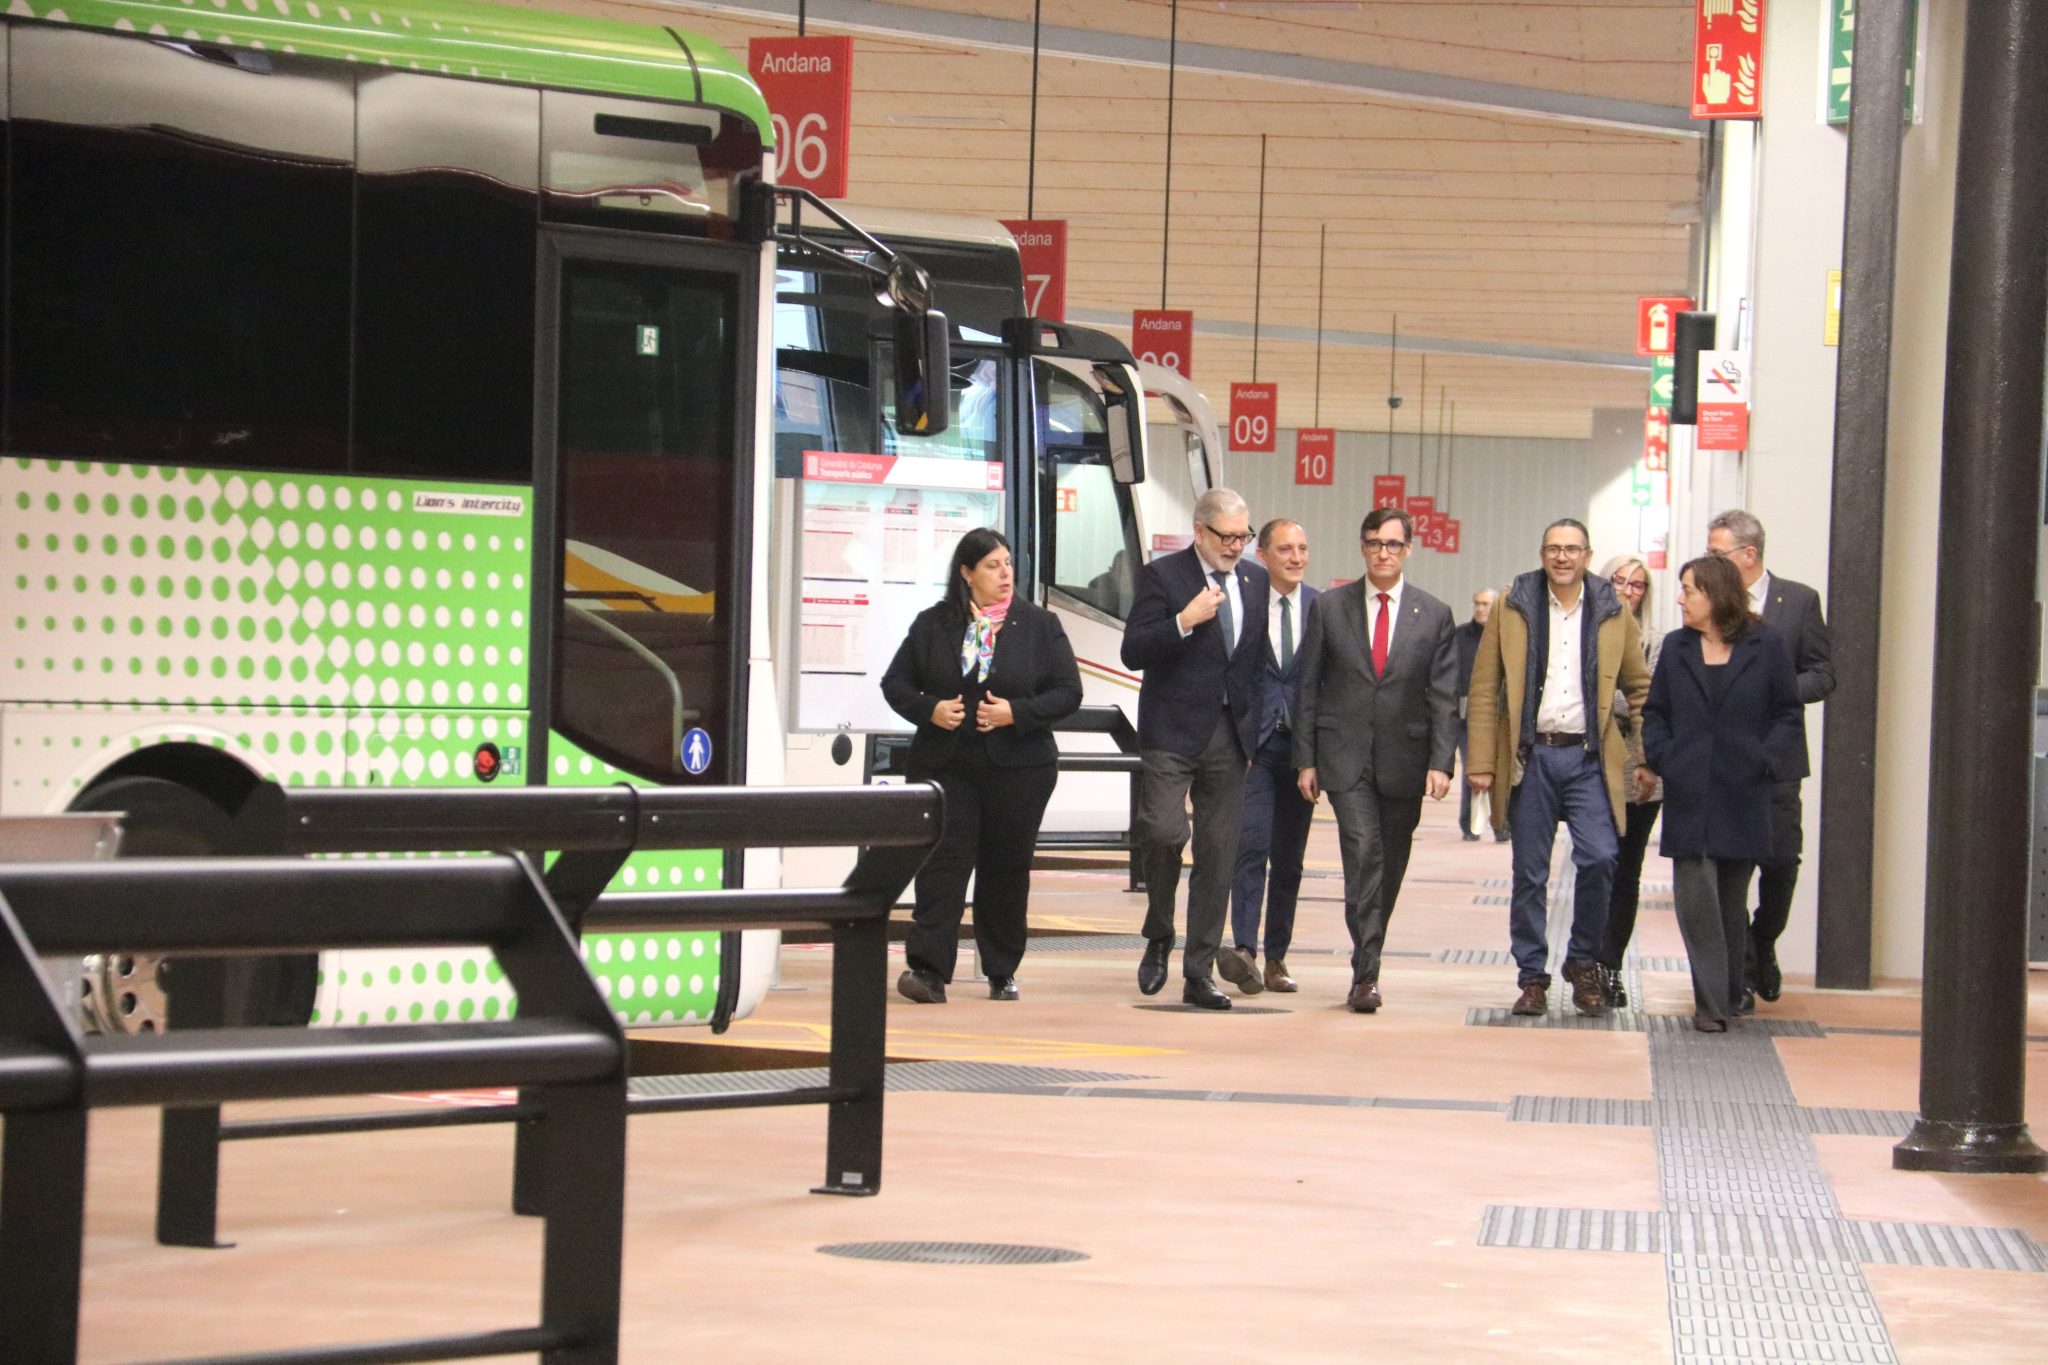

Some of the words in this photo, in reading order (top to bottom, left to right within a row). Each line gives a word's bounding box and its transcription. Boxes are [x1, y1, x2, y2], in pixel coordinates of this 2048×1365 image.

[761, 52, 831, 73] Andana
[1013, 231, 1052, 246] ndana
[1027, 274, 1051, 318] 7
[1140, 318, 1183, 330] Andana
[1236, 389, 1269, 399] Andana
[1234, 415, 1269, 444] 09
[1301, 433, 1329, 442] Andana
[1300, 454, 1327, 479] 10
